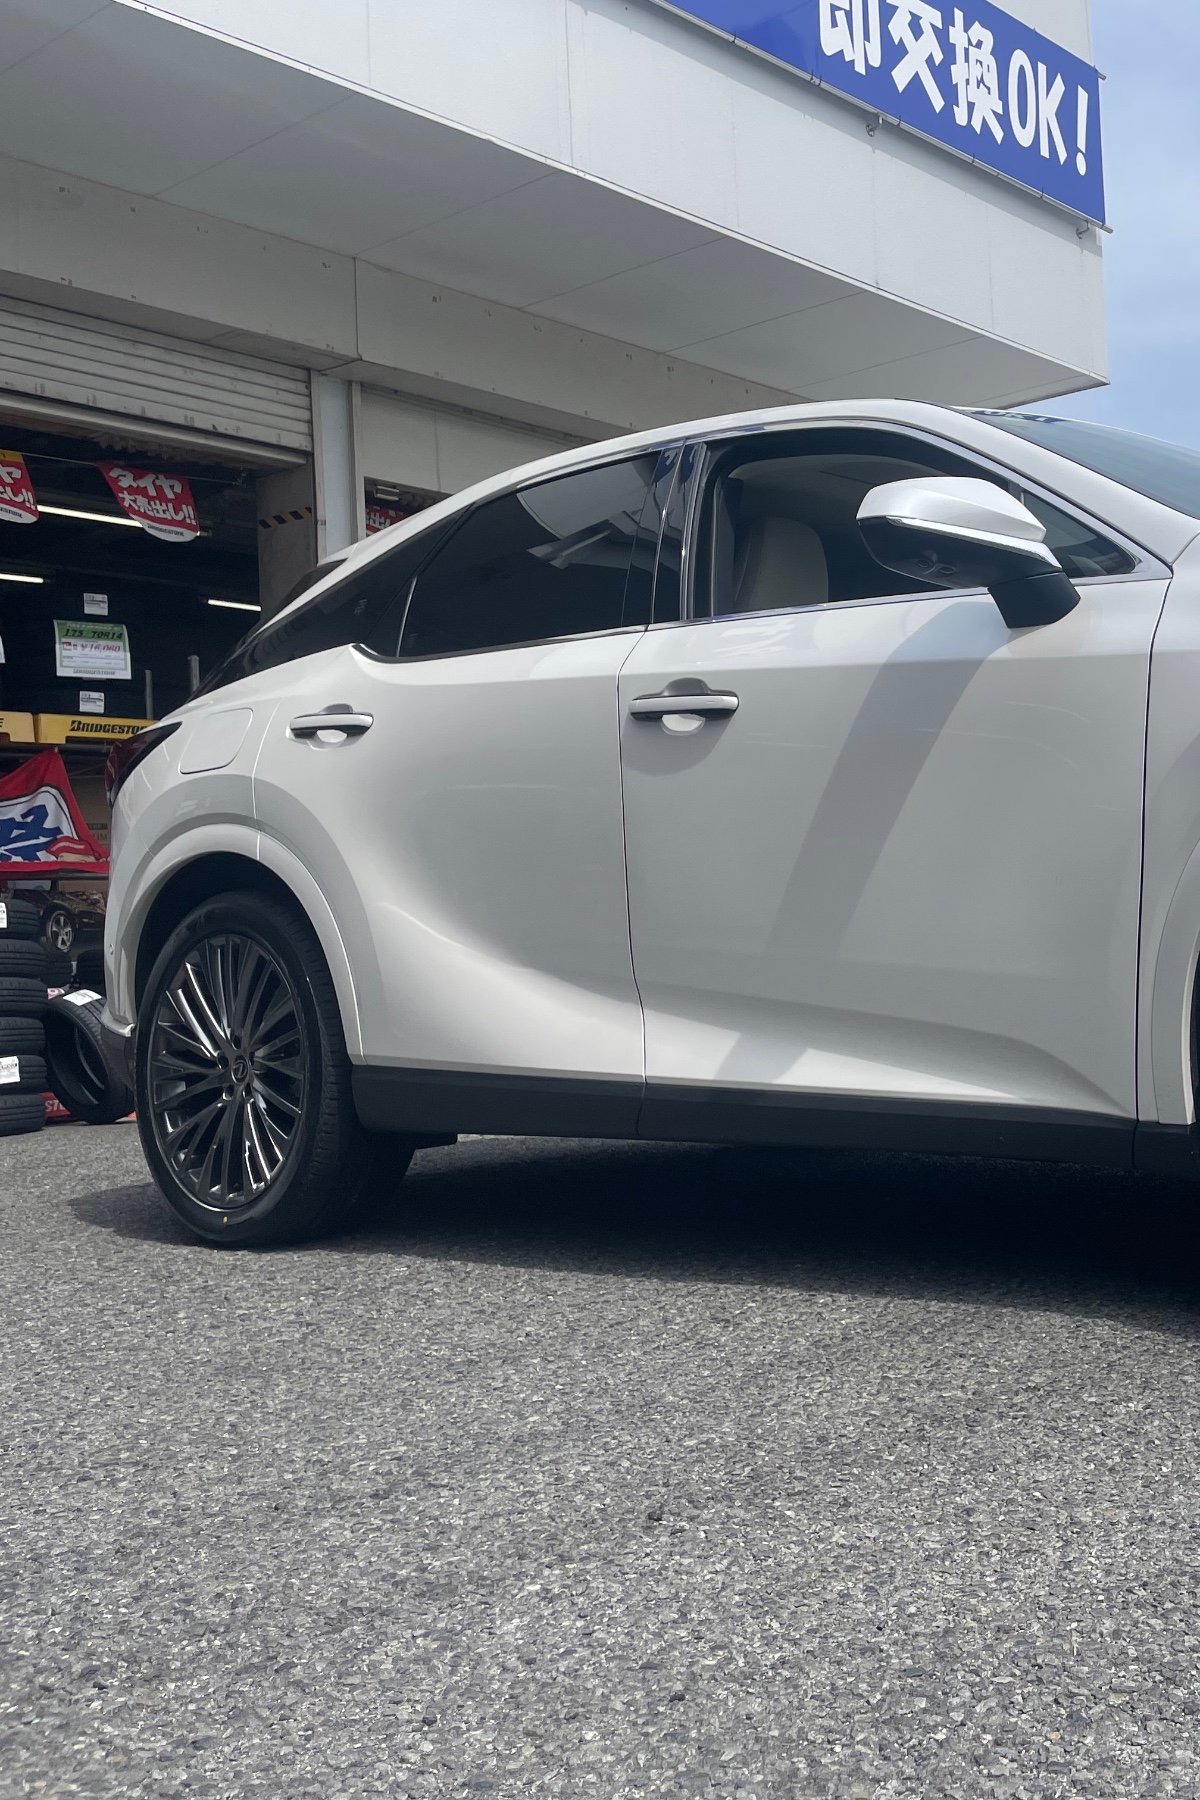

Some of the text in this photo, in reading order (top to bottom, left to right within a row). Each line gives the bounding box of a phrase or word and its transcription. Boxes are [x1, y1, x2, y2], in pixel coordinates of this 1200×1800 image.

[109, 467, 182, 499] タイヤ
[118, 490, 197, 526] 大売出し!!
